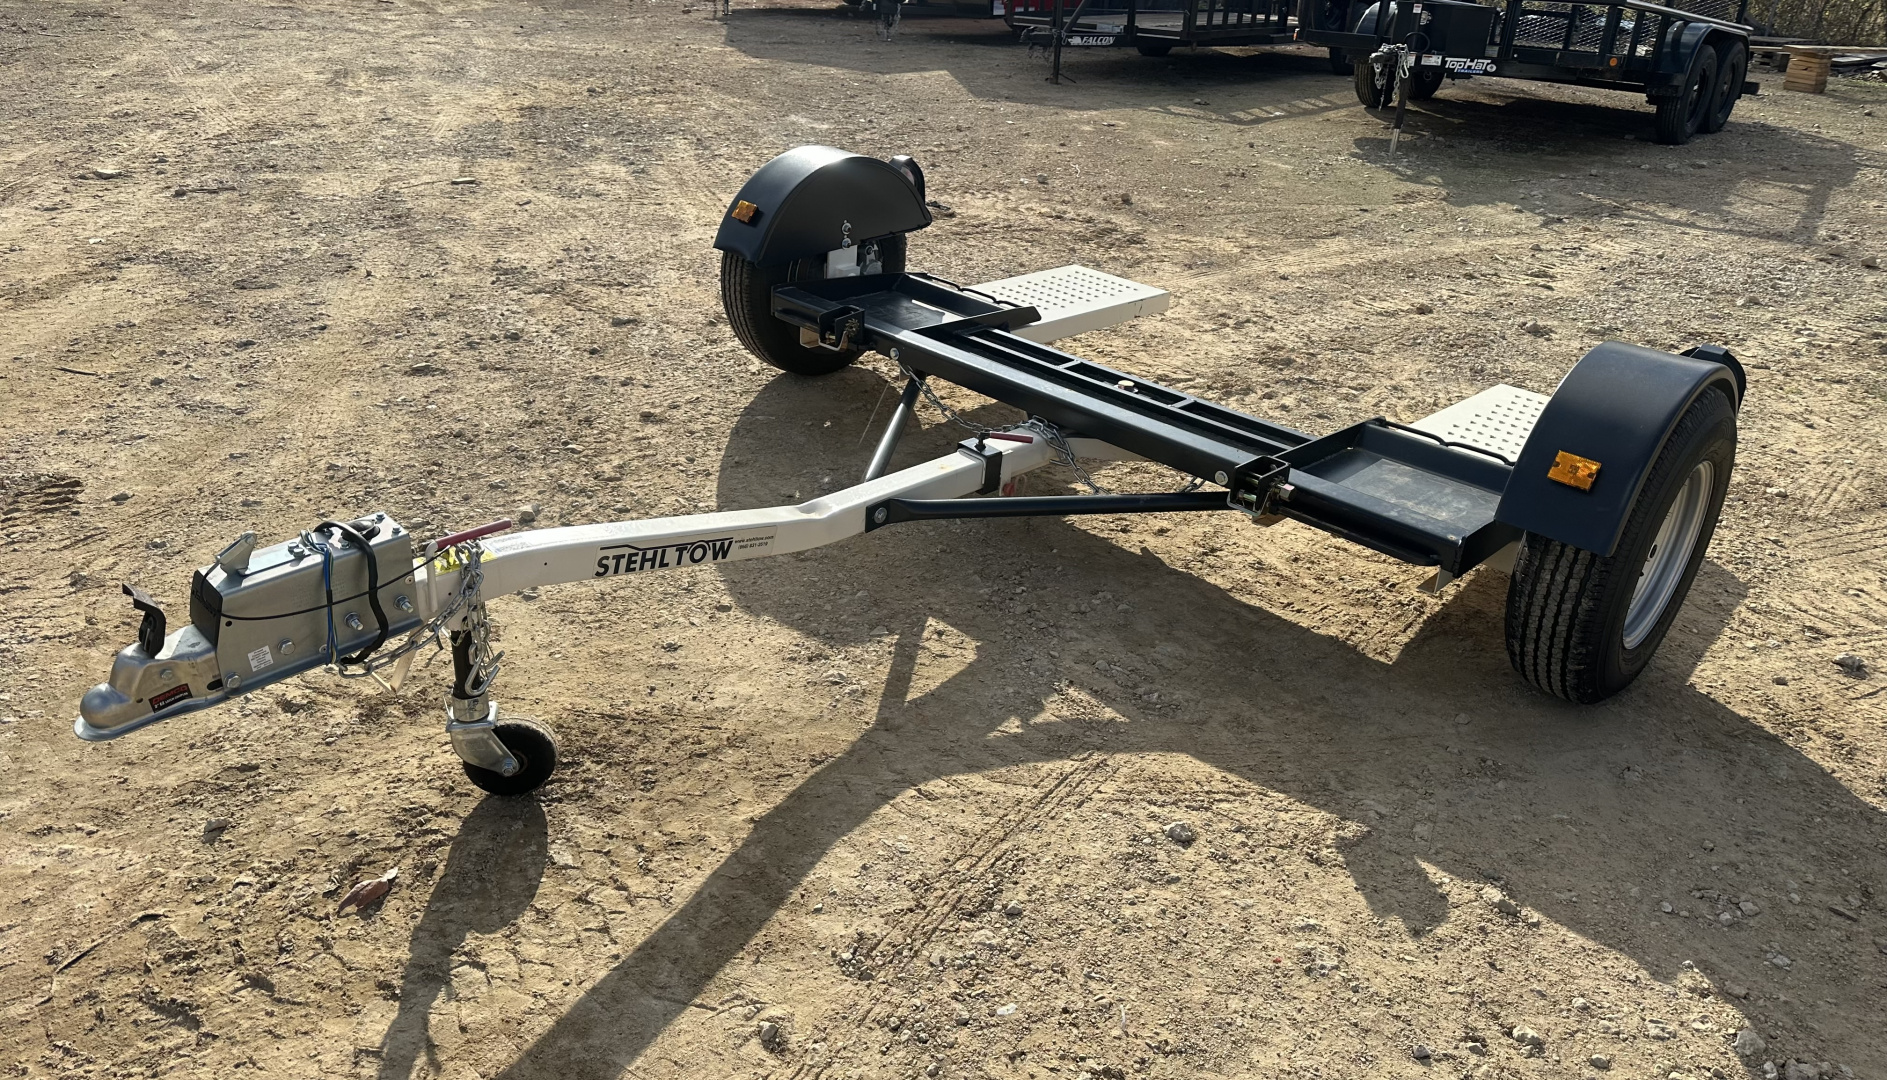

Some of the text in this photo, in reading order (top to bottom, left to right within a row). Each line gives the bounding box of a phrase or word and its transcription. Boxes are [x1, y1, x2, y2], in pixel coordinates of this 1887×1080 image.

[1082, 36, 1116, 44] FALCON
[594, 540, 734, 577] STEHL TOW
[153, 685, 188, 704] DEMCO
